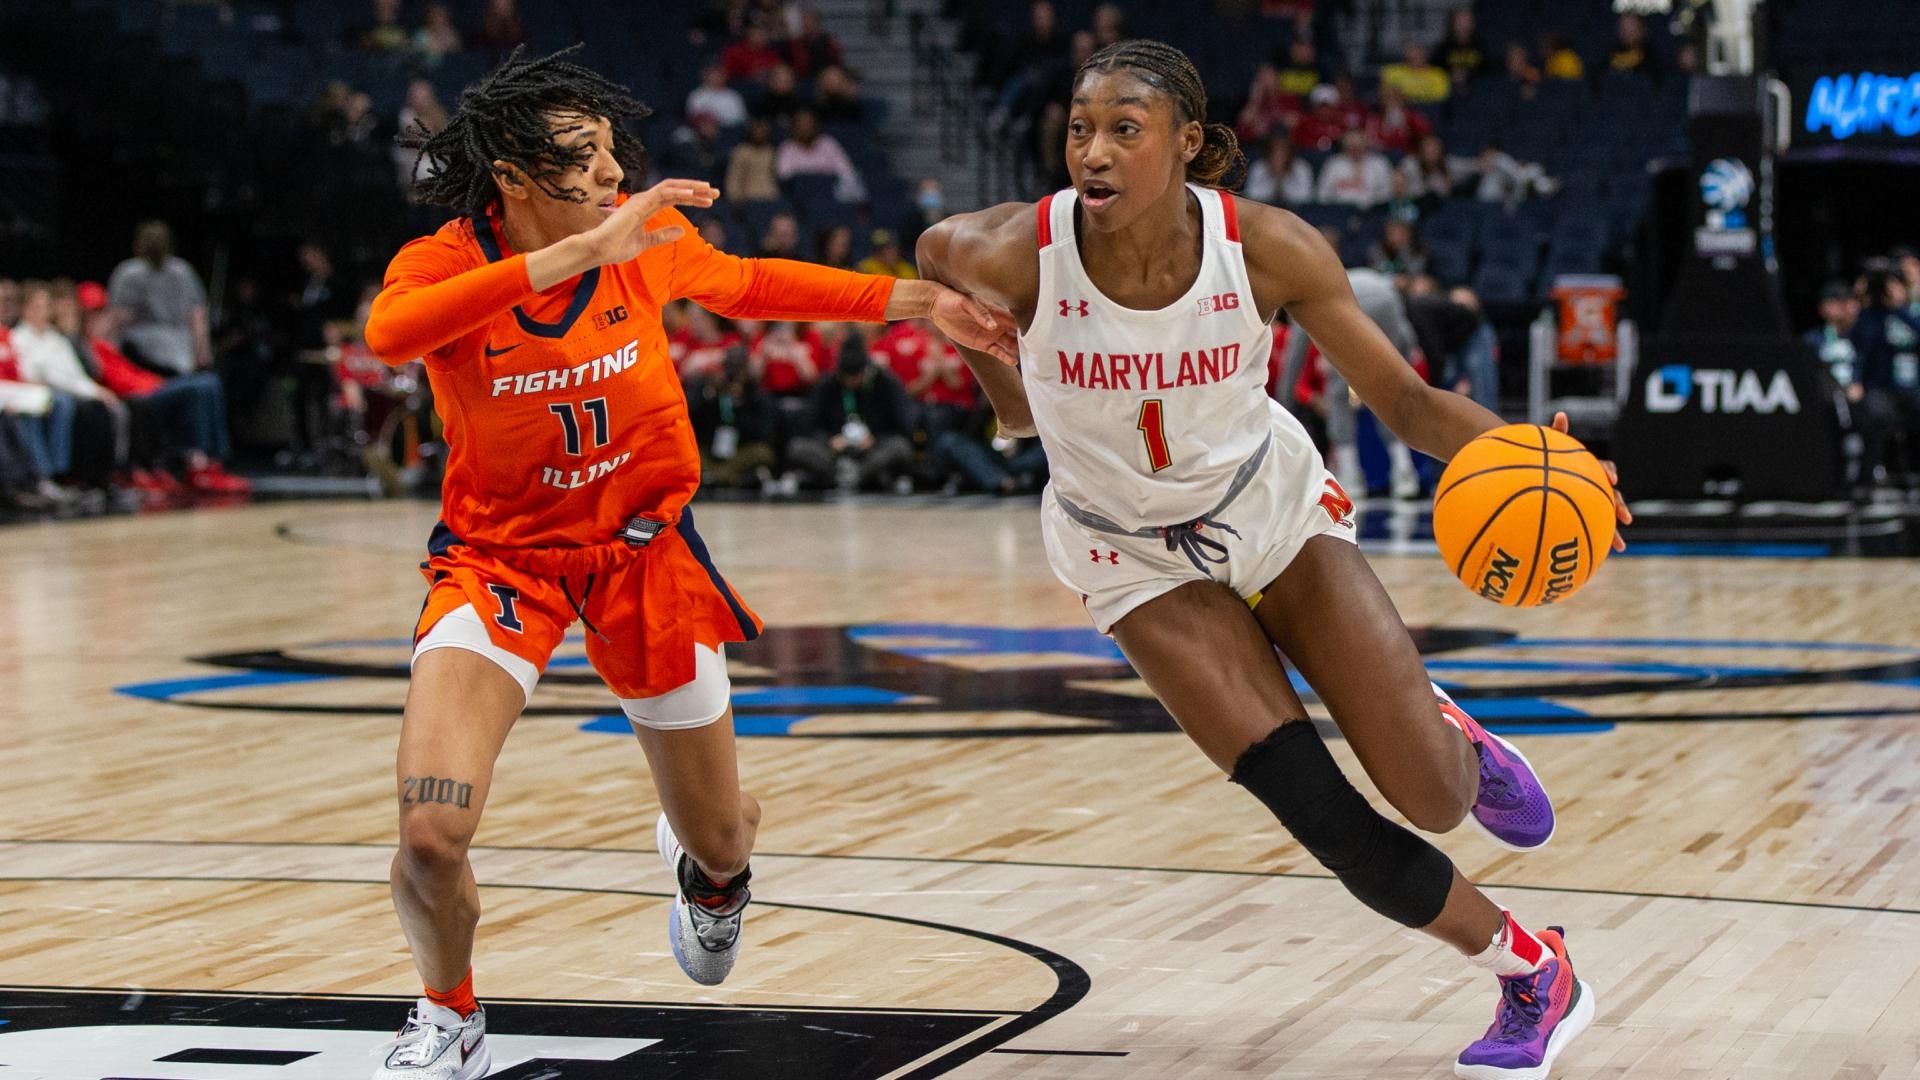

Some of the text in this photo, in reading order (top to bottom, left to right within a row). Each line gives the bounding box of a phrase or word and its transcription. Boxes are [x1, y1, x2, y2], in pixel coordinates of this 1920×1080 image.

[491, 339, 639, 397] FIGHTING
[1057, 343, 1241, 391] MARYLAND
[1693, 368, 1800, 414] TIAA
[548, 396, 610, 457] 11
[1137, 399, 1173, 474] 1
[1536, 536, 1579, 606] Wil
[488, 583, 524, 634] I
[403, 775, 474, 809] 2000
